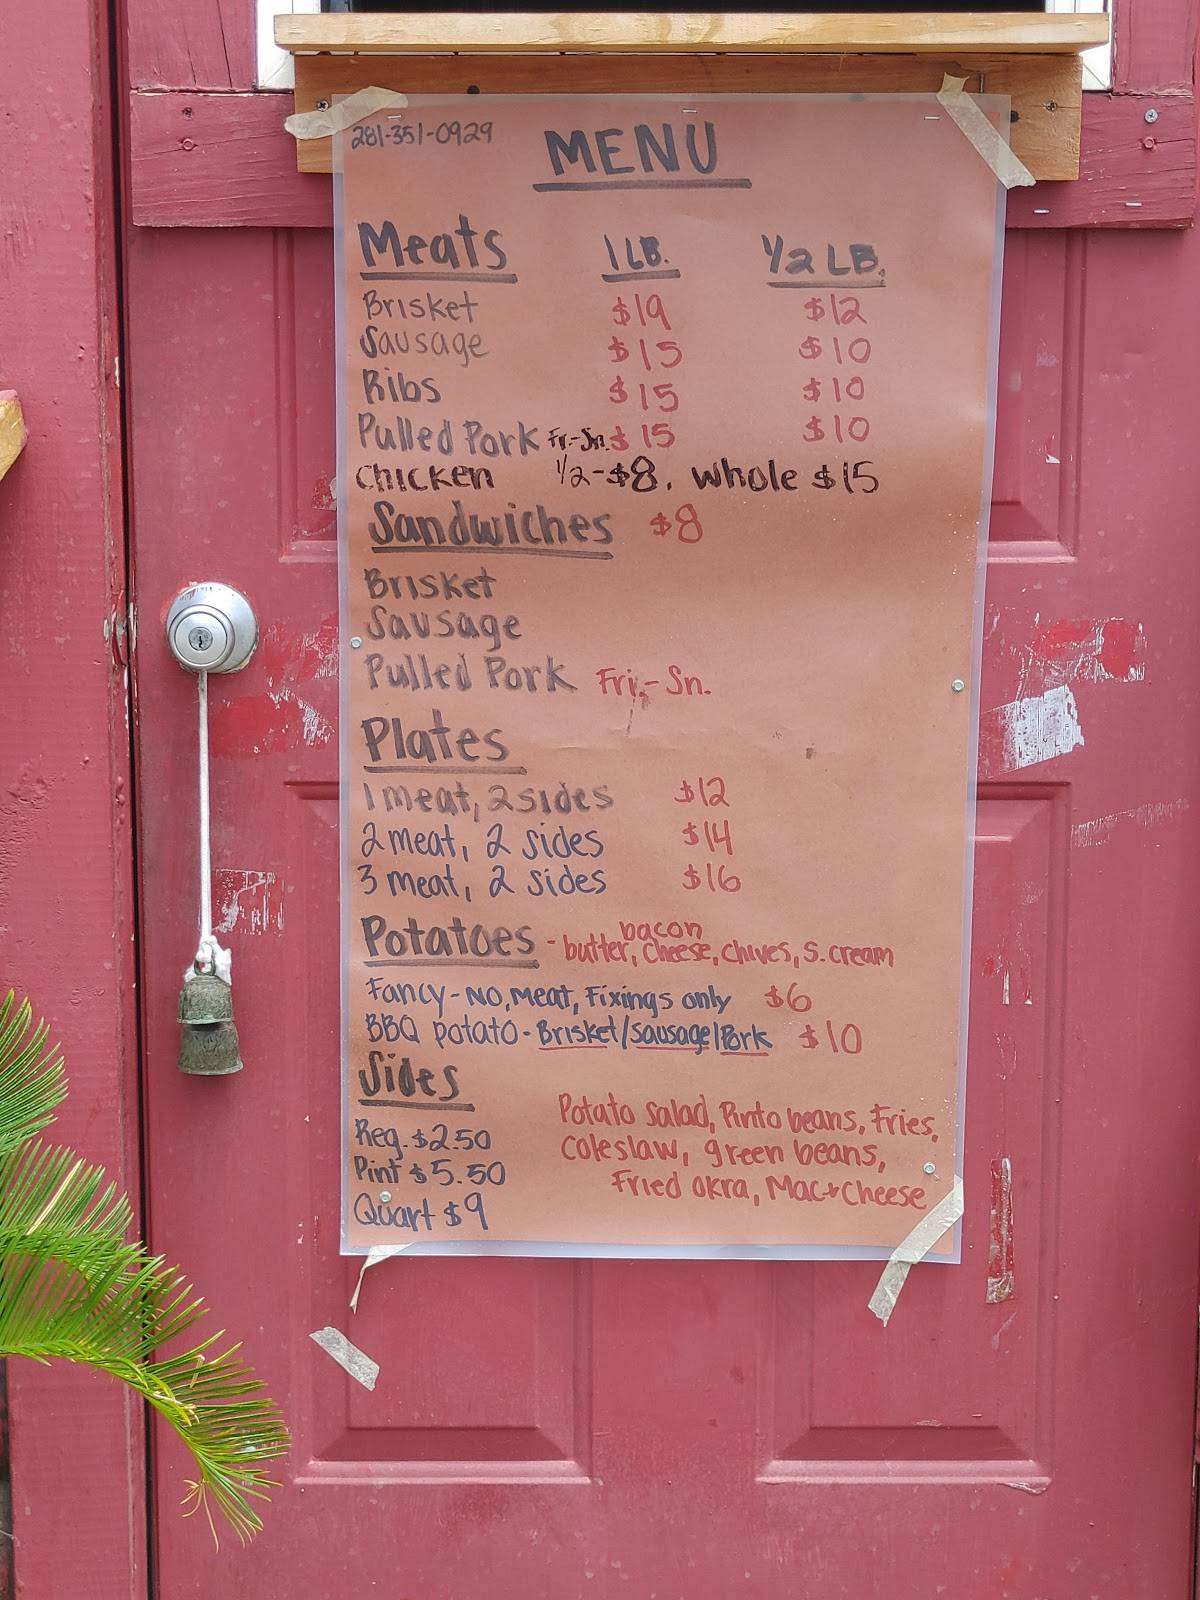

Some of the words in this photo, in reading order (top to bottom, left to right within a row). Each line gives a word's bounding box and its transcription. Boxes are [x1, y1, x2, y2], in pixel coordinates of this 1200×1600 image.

[352, 120, 495, 149] 281-351-0929
[544, 122, 718, 176] MENU
[357, 214, 507, 270] Meats
[604, 234, 619, 270] 1
[625, 235, 669, 270] LB.
[761, 234, 814, 273] 1/2
[362, 289, 478, 323] Brisket
[612, 293, 672, 331] $19
[803, 294, 867, 326] $12
[359, 325, 489, 368] Sausage
[608, 336, 683, 371] $15
[799, 336, 872, 364] $10
[362, 367, 442, 404] Ribs
[609, 376, 679, 413] $15
[803, 376, 866, 402] $10
[358, 412, 453, 456] Pulled
[463, 420, 540, 457] Pork
[610, 423, 676, 451] $15
[803, 414, 870, 443] $10
[811, 460, 879, 494] $15
[368, 500, 614, 548] Sandwiches
[650, 503, 703, 544] $8
[363, 566, 497, 601] Brisket
[366, 604, 523, 652] Sausage
[364, 652, 472, 691] Pulled
[484, 655, 579, 693] Pork
[360, 708, 510, 764] Plates
[362, 781, 375, 811] 1
[381, 781, 481, 823] meat,
[518, 781, 614, 816] sides
[674, 776, 730, 808] $12
[361, 821, 384, 858] 2
[388, 822, 469, 862] meat,
[486, 822, 512, 859] 2
[681, 819, 733, 855] $14
[357, 863, 378, 896] 3
[386, 863, 472, 901] meat,
[488, 864, 514, 898] 2
[681, 863, 742, 893] $16
[361, 915, 536, 957] Potatoes
[619, 920, 703, 941] bacon
[681, 984, 732, 1014] only
[763, 982, 813, 1013] $6
[365, 1013, 421, 1044] BBQ
[798, 1020, 862, 1054] $10
[358, 1050, 460, 1101] Sides
[558, 1092, 636, 1127] Potato
[719, 1099, 782, 1129] Pinto
[786, 1107, 865, 1136] beans,
[870, 1102, 939, 1143] Fries,
[354, 1118, 408, 1161] Reg.
[411, 1123, 492, 1152] $2.50
[561, 1134, 690, 1167] Coleslaw,
[704, 1139, 785, 1168] green
[793, 1141, 887, 1174] beans,
[354, 1155, 402, 1184] Pint
[409, 1158, 506, 1186] $5.50
[611, 1169, 681, 1199] Fried
[353, 1192, 436, 1232] Quart
[443, 1192, 489, 1231] $9
